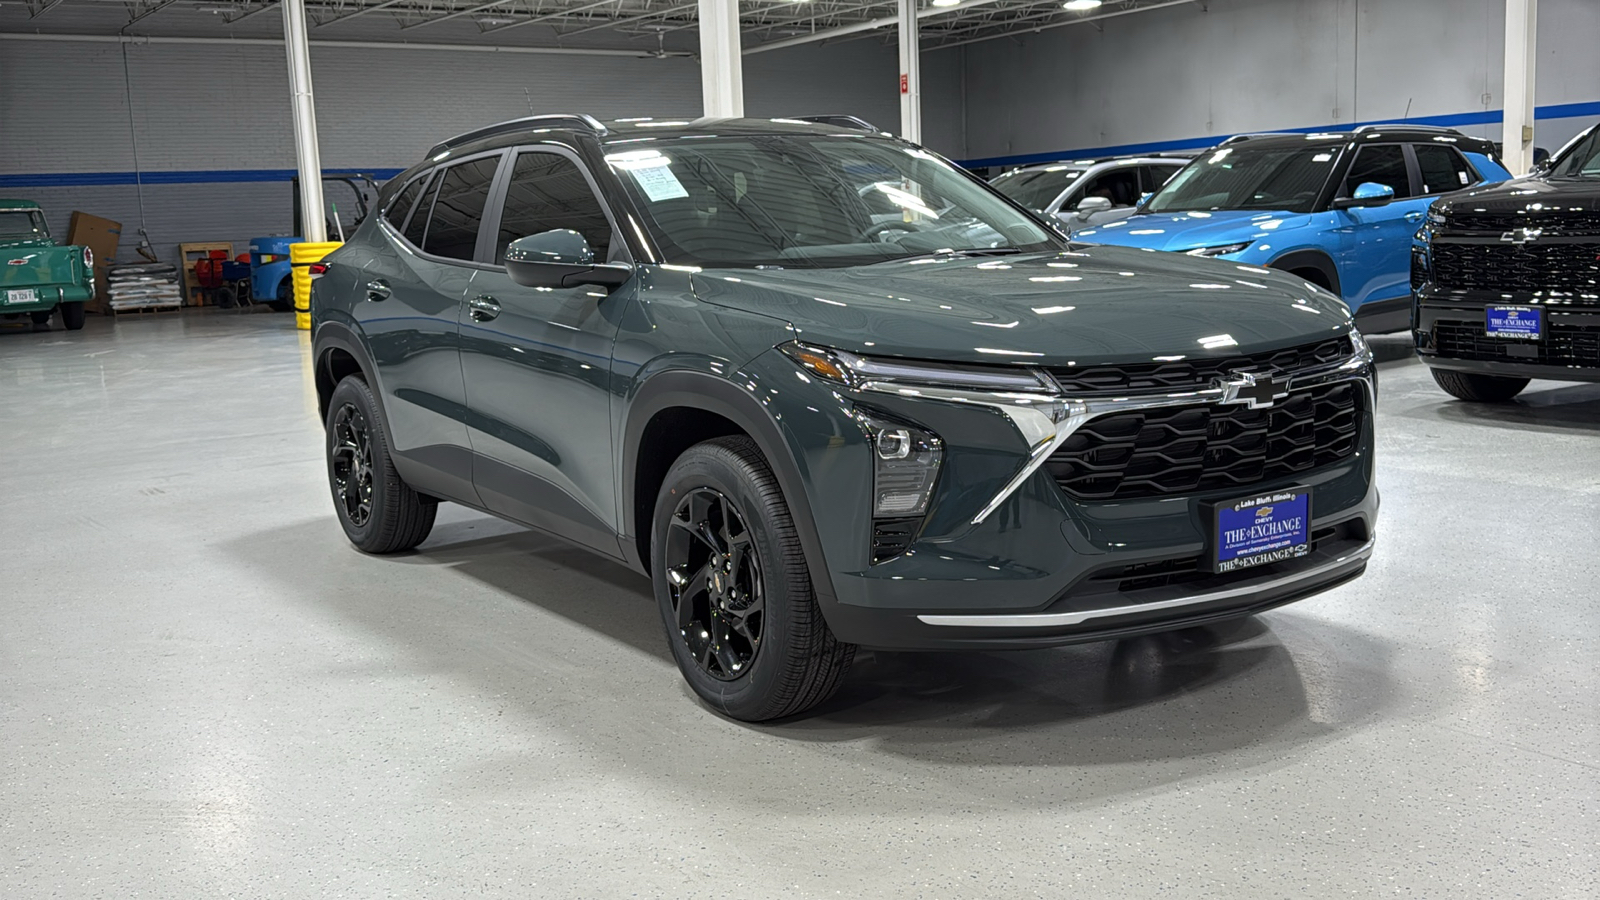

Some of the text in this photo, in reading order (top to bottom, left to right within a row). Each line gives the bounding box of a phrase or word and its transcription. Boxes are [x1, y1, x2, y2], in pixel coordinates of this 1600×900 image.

[1241, 500, 1255, 508] Lake
[1255, 516, 1273, 524] CHEVY
[1225, 517, 1301, 544] THE EXCHANGE
[1219, 561, 1235, 572] THE
[1243, 549, 1290, 567] EXCHANGE
